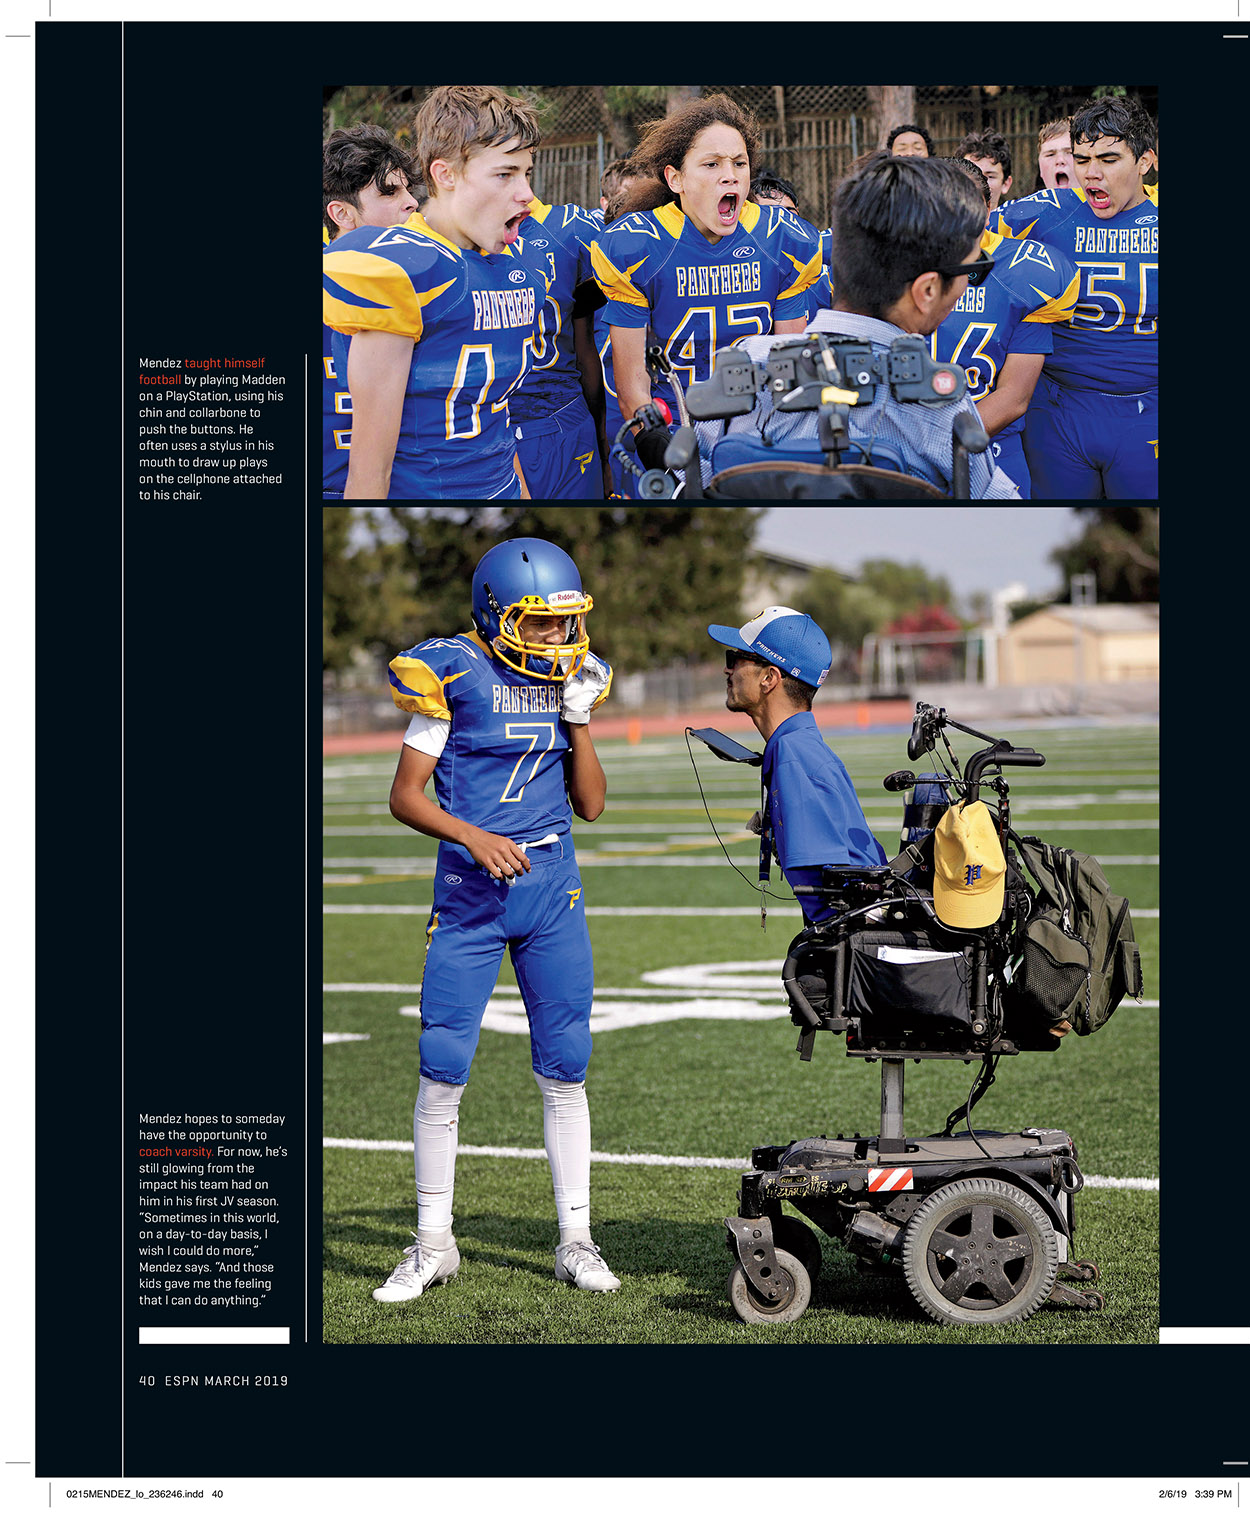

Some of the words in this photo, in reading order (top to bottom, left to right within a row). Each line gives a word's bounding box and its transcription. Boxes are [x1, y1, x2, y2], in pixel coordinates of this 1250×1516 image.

[1075, 227, 1158, 253] PANTHERS
[676, 261, 761, 297] PANTHERS
[472, 287, 535, 330] PANTHERS
[756, 641, 786, 663] PANTHERS
[500, 723, 556, 802] 7
